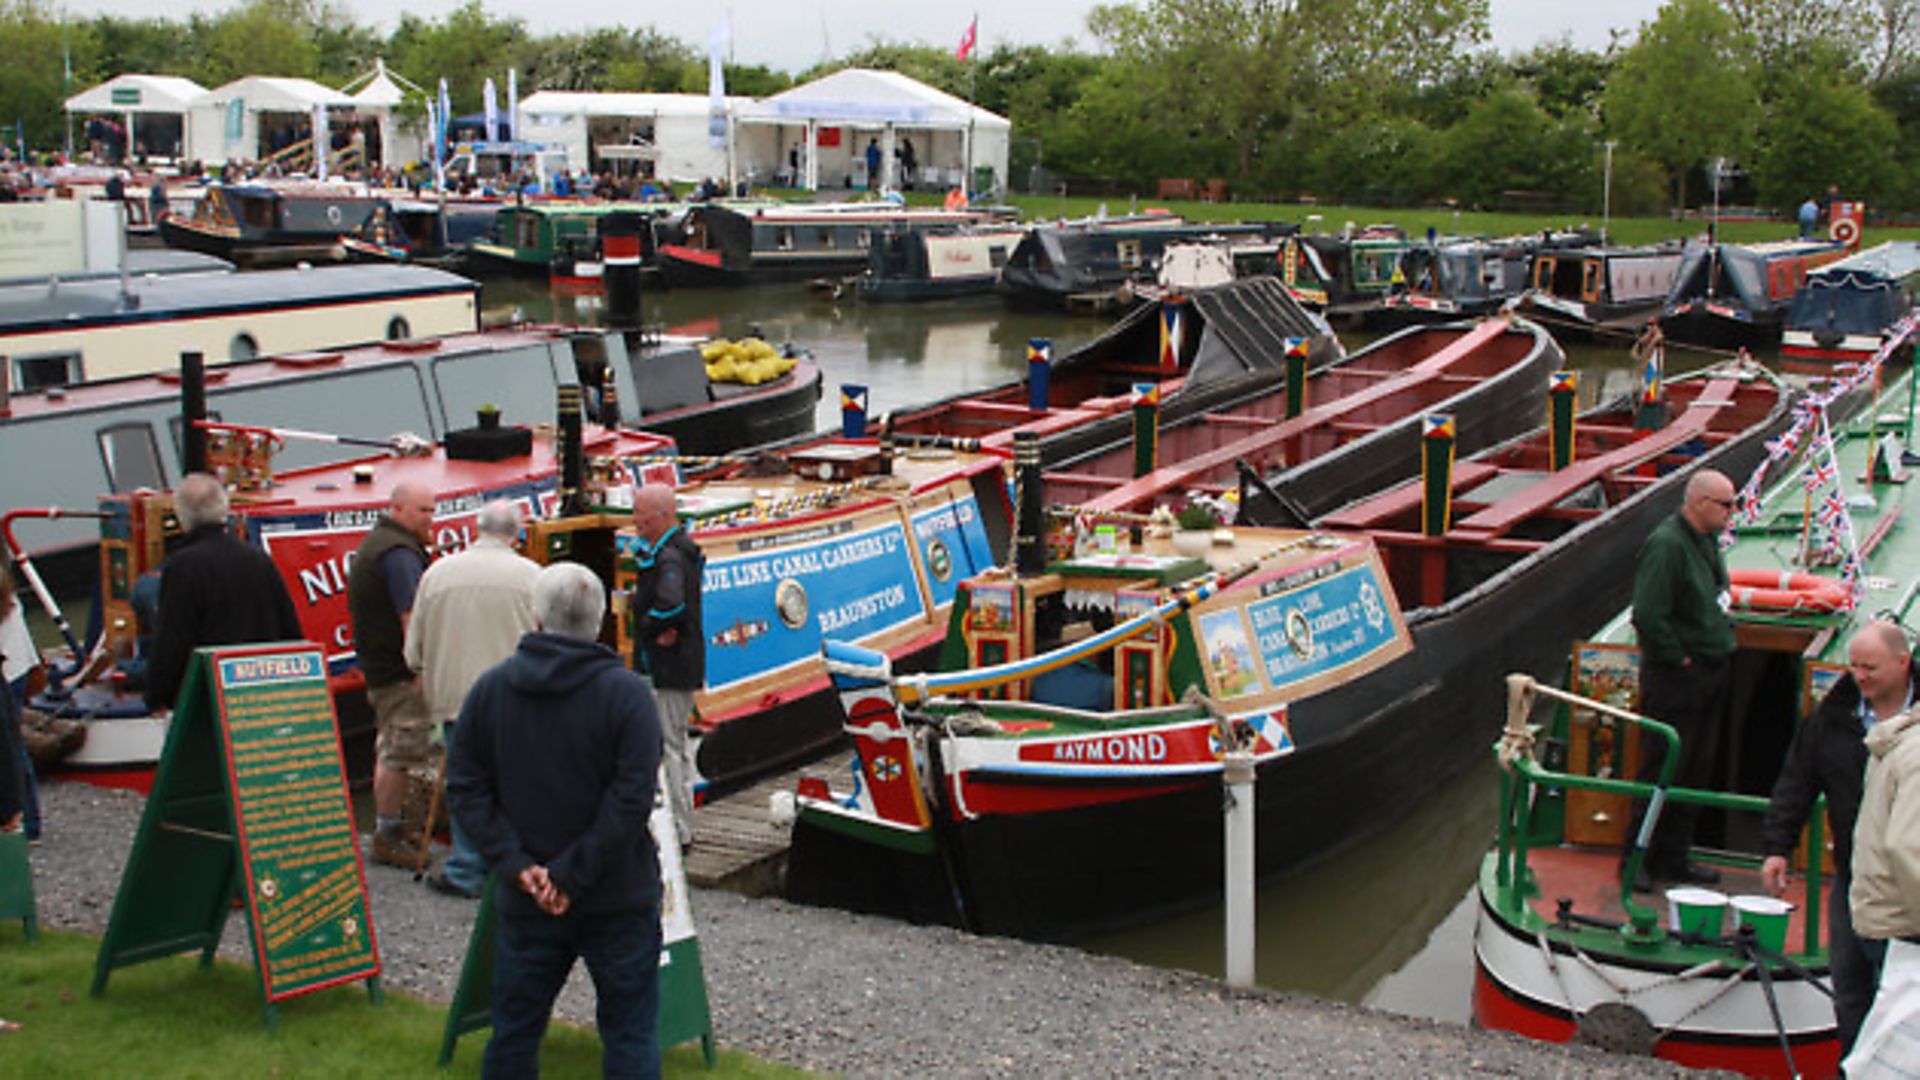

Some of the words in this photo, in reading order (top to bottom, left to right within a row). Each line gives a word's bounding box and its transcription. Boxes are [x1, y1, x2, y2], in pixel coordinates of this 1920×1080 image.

[732, 559, 771, 587] LINE
[772, 551, 822, 579] CANAL
[822, 535, 884, 569] CARRIERS
[817, 584, 905, 632] BRAUNSTON
[233, 658, 312, 681] NUTFIELD
[1053, 734, 1167, 762] RAYMOND
